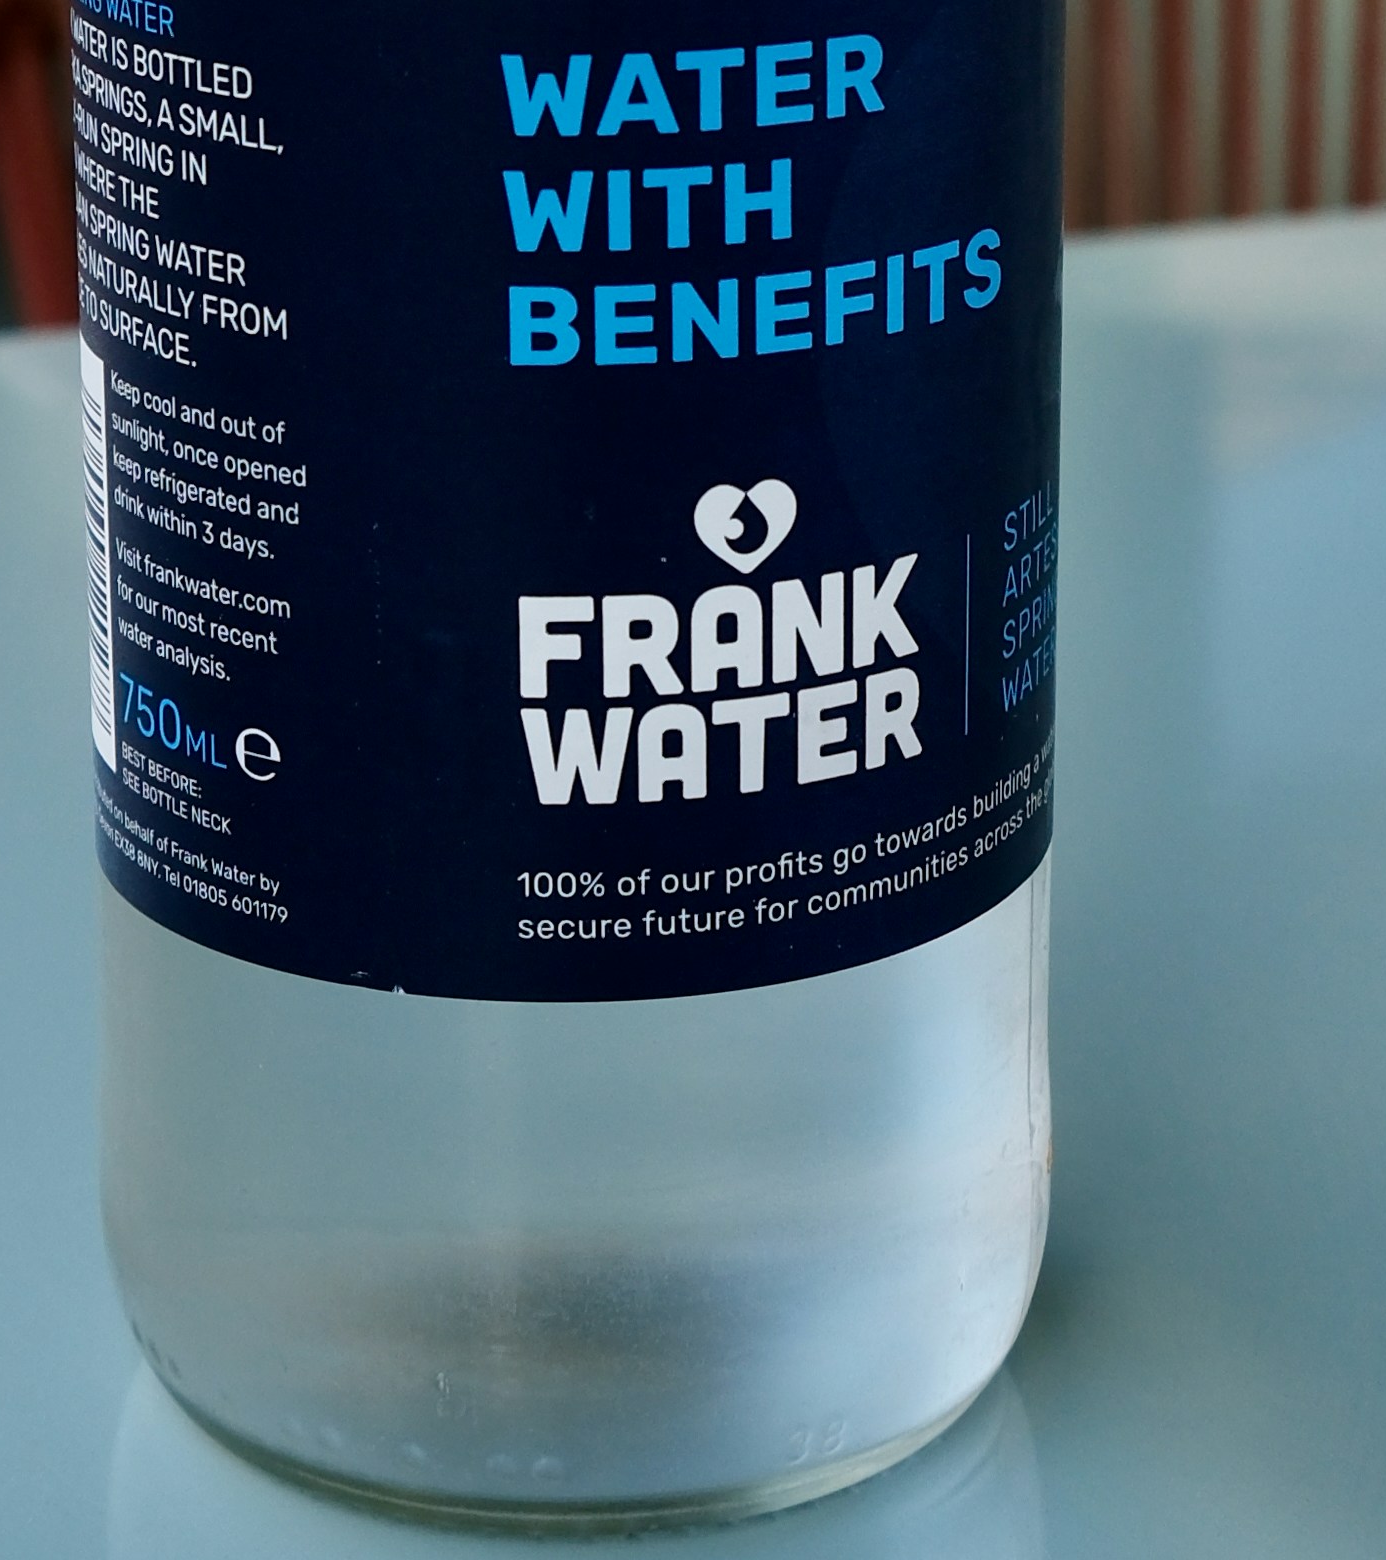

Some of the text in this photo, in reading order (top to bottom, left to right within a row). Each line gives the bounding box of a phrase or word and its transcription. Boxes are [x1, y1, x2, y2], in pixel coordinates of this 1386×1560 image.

[111, 36, 128, 70] IS
[133, 44, 252, 99] BOTTLED
[500, 34, 885, 137] WATER
[81, 64, 152, 128] SPRINGS,
[157, 98, 174, 131] A
[179, 103, 284, 155] SMALL,
[77, 149, 116, 203] WHERE
[118, 176, 160, 219] THE
[101, 123, 174, 177] SPRING
[182, 150, 207, 186] IN
[502, 158, 792, 252] WITH
[90, 204, 150, 261] SPRING
[155, 235, 246, 287] WATER
[89, 249, 195, 319] NATURALLY
[203, 293, 288, 341] FROM
[100, 300, 197, 368] SURFACE.
[508, 228, 1002, 366] BENEFITS
[110, 369, 286, 445] Keep cool and out of
[111, 412, 307, 488] sunlight, once opened
[113, 444, 299, 525] keep refrigerated and
[114, 484, 275, 560] drink within 3 days.
[1004, 481, 1053, 551] STILL
[115, 537, 291, 619] Visit frankwater.com
[116, 575, 278, 654] for our most recent
[118, 616, 231, 682] water analysis.
[519, 553, 919, 698] FRANK
[121, 741, 145, 771] BEST
[148, 758, 202, 799] BEFORE:
[520, 667, 923, 806] WATER
[122, 767, 141, 795] SEE
[142, 784, 187, 820] BOTTLE
[191, 805, 232, 835] NECK
[517, 871, 605, 898] 100%
[617, 868, 651, 896] of
[661, 870, 715, 894] our
[726, 851, 823, 894] profits
[833, 843, 866, 875] go
[874, 805, 967, 857] towards
[973, 762, 1031, 819] building
[1033, 754, 1040, 771] a
[114, 805, 280, 896] on behalf of Frank Water by
[518, 790, 1042, 939] secure future for communities across the
[162, 865, 180, 888] Tel
[183, 875, 227, 906] 01805
[232, 895, 288, 923] 601179
